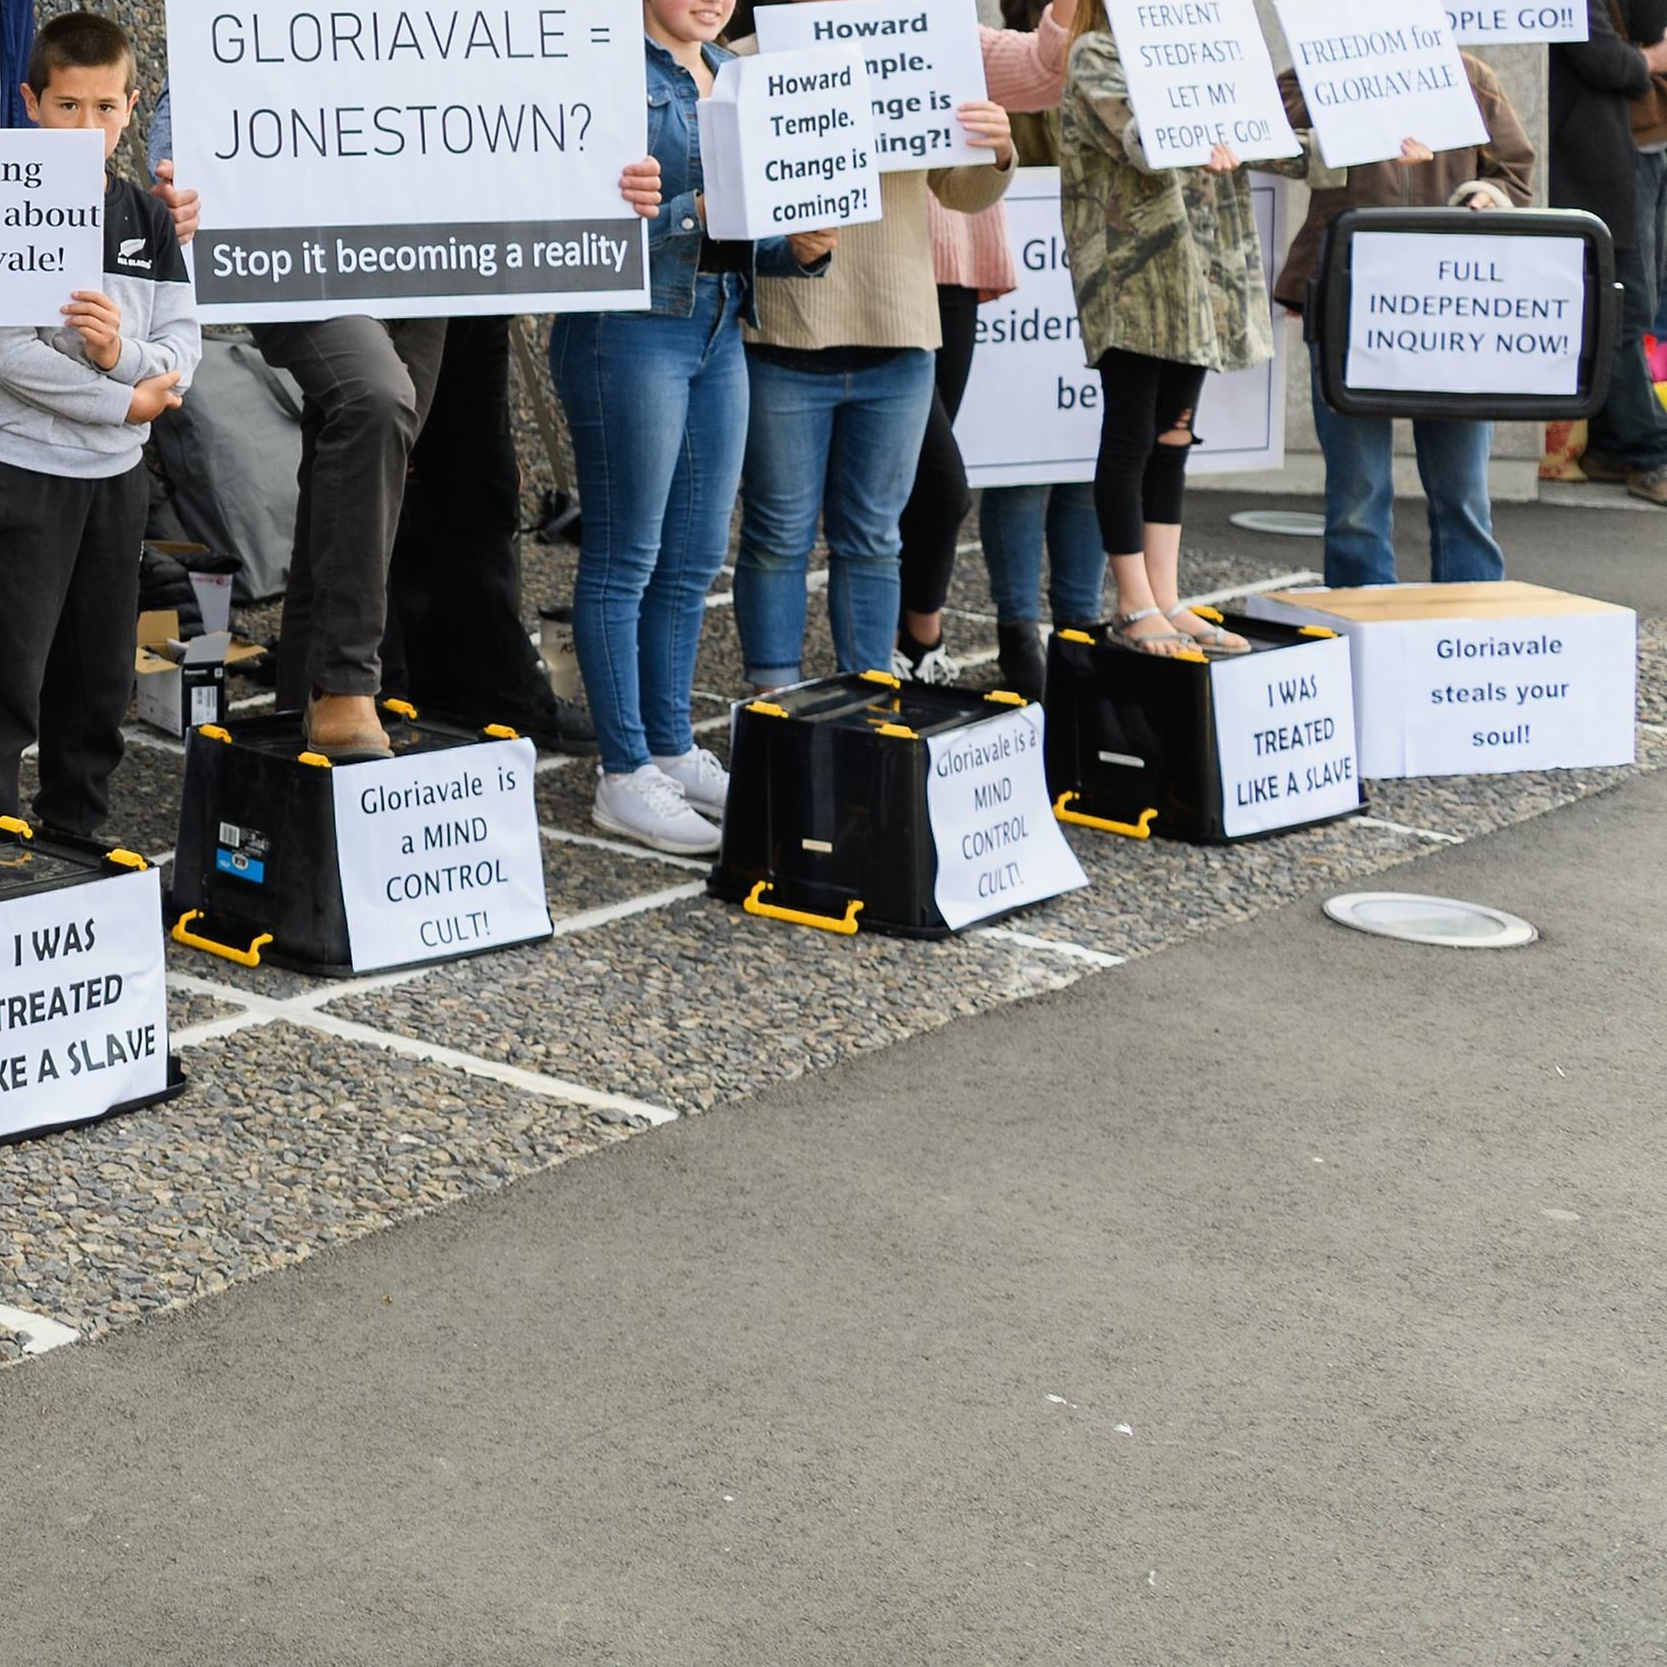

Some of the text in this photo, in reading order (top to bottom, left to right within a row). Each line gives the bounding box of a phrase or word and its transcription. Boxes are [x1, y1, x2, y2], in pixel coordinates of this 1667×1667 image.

[814, 13, 928, 40] Howard
[1138, 2, 1221, 27] FERVENT
[1445, 8, 1573, 30] PLE GO!!
[211, 9, 610, 64] GLORIAVALE =
[1140, 40, 1243, 67] STEDFAST!
[1300, 25, 1442, 65] FREEDOM for
[768, 66, 851, 96] Howard
[865, 53, 932, 79] mple.
[1168, 83, 1236, 108] LET MY
[1315, 64, 1458, 106] GLORIAVALE
[871, 90, 951, 119] nge is
[214, 103, 592, 160] JONESTOWN?
[771, 108, 854, 137] Temple.
[1156, 120, 1272, 150] PEOPLE GO!!
[875, 128, 951, 156] ing?!
[766, 148, 867, 182] Change is
[4, 199, 101, 229] about
[773, 188, 868, 222] coming?!
[212, 232, 627, 282] Stop it becoming a reality
[1439, 261, 1504, 282] FULL
[1370, 294, 1569, 319] INDEPENDENT
[976, 308, 1082, 343] esiden
[1367, 330, 1569, 355] INQUIRY NOW!
[1437, 635, 1563, 659] Gloriavale
[1268, 674, 1317, 708] I WAS
[1431, 680, 1569, 706] steals your
[1254, 717, 1335, 757] TREATED
[1472, 725, 1531, 747] soul!
[937, 730, 1036, 777] Gloriavale is a
[361, 767, 516, 815] Gloriavale is
[974, 778, 1012, 811] MIND
[1237, 757, 1352, 807] LIKE A SLAVE
[401, 817, 488, 854] a MIND
[962, 816, 1029, 860] CONTROL
[386, 859, 509, 903] CONTROL
[978, 862, 1024, 898] CULT!
[14, 918, 95, 966] I WAS
[420, 911, 491, 948] CULT!
[38, 1049, 60, 1083] A
[67, 1024, 156, 1076] SLAVE
